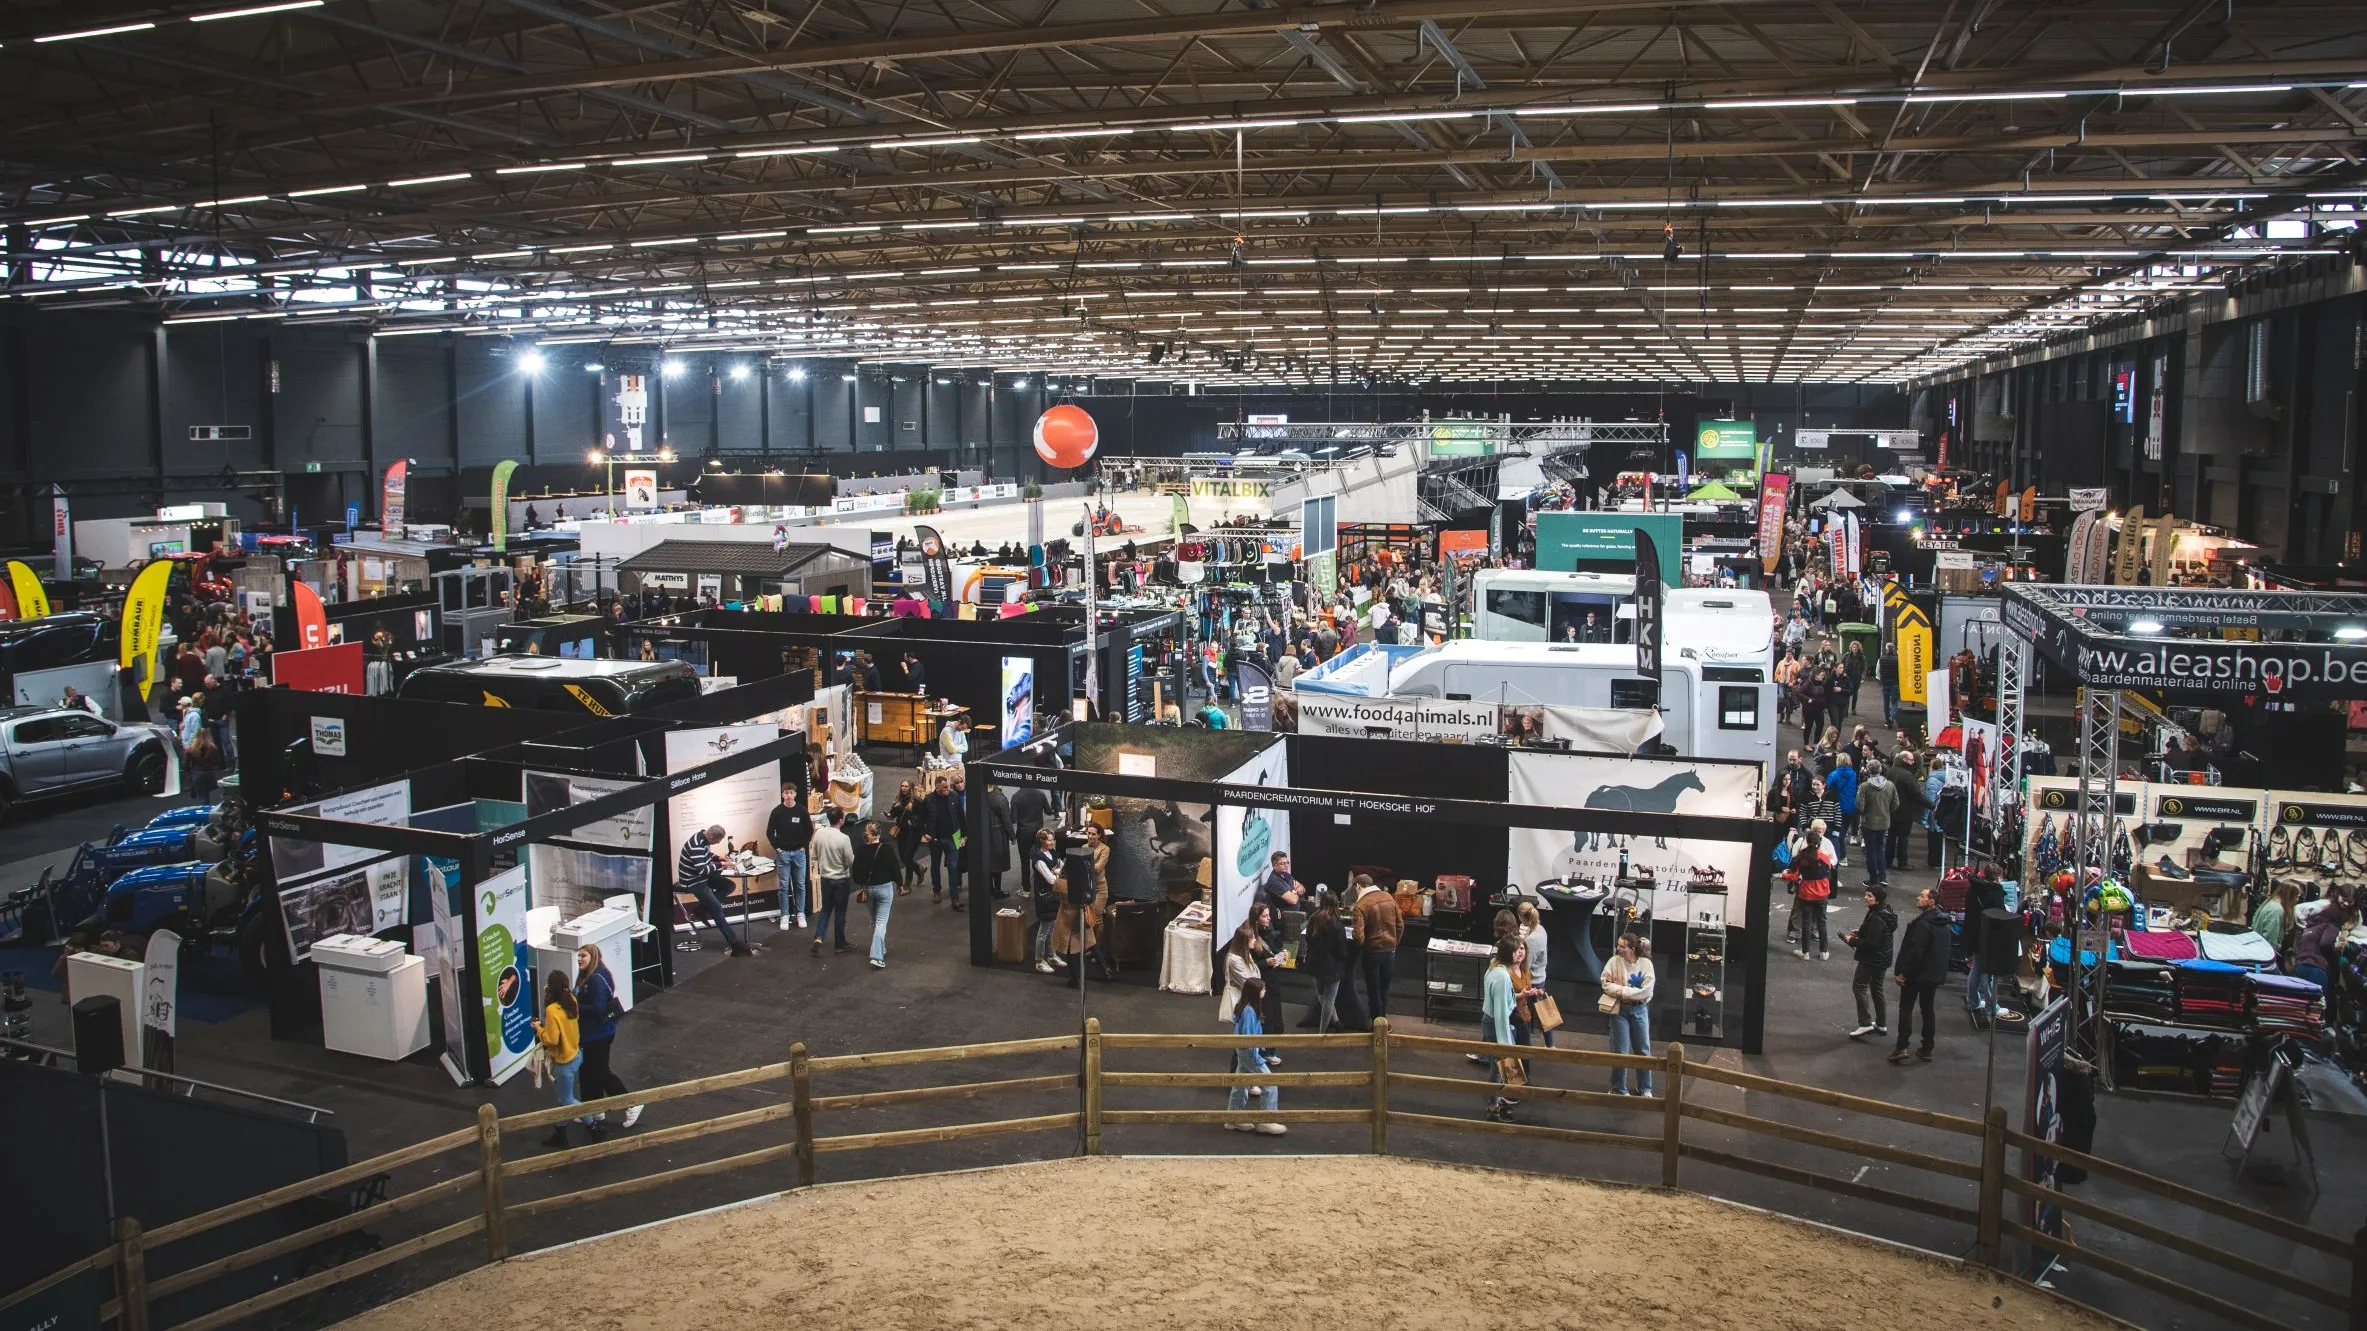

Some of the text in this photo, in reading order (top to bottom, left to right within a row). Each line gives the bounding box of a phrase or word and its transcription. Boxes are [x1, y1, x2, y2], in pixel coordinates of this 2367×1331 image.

[1192, 481, 1270, 497] VITALBIX
[1918, 541, 1957, 549] KEY-TEC
[2070, 517, 2088, 584] ASTLOADERS
[2088, 525, 2105, 585] STLOADERS
[654, 574, 684, 582] MATTHYS
[132, 600, 143, 651] HUMBAUR
[1638, 595, 1654, 670] HKM
[2212, 677, 2257, 691] online
[576, 688, 588, 703] TE
[1302, 703, 1493, 727] www.food4animals.nl
[315, 729, 342, 739] THOMAS
[1325, 725, 1351, 735] alles
[691, 771, 707, 782] Horse
[992, 769, 1022, 779] Vakantie
[1036, 773, 1058, 783] Paard
[1224, 790, 1436, 813] PAARDENCREMATORIUM HET HOEKSCHE HOF
[2194, 805, 2243, 816] WWW.BR.NL
[2316, 813, 2367, 823] WWW.BR.NL
[268, 819, 301, 832] HorSense
[493, 829, 526, 846] HorSense
[379, 879, 402, 892] KRACHT
[379, 890, 399, 902] STAAN
